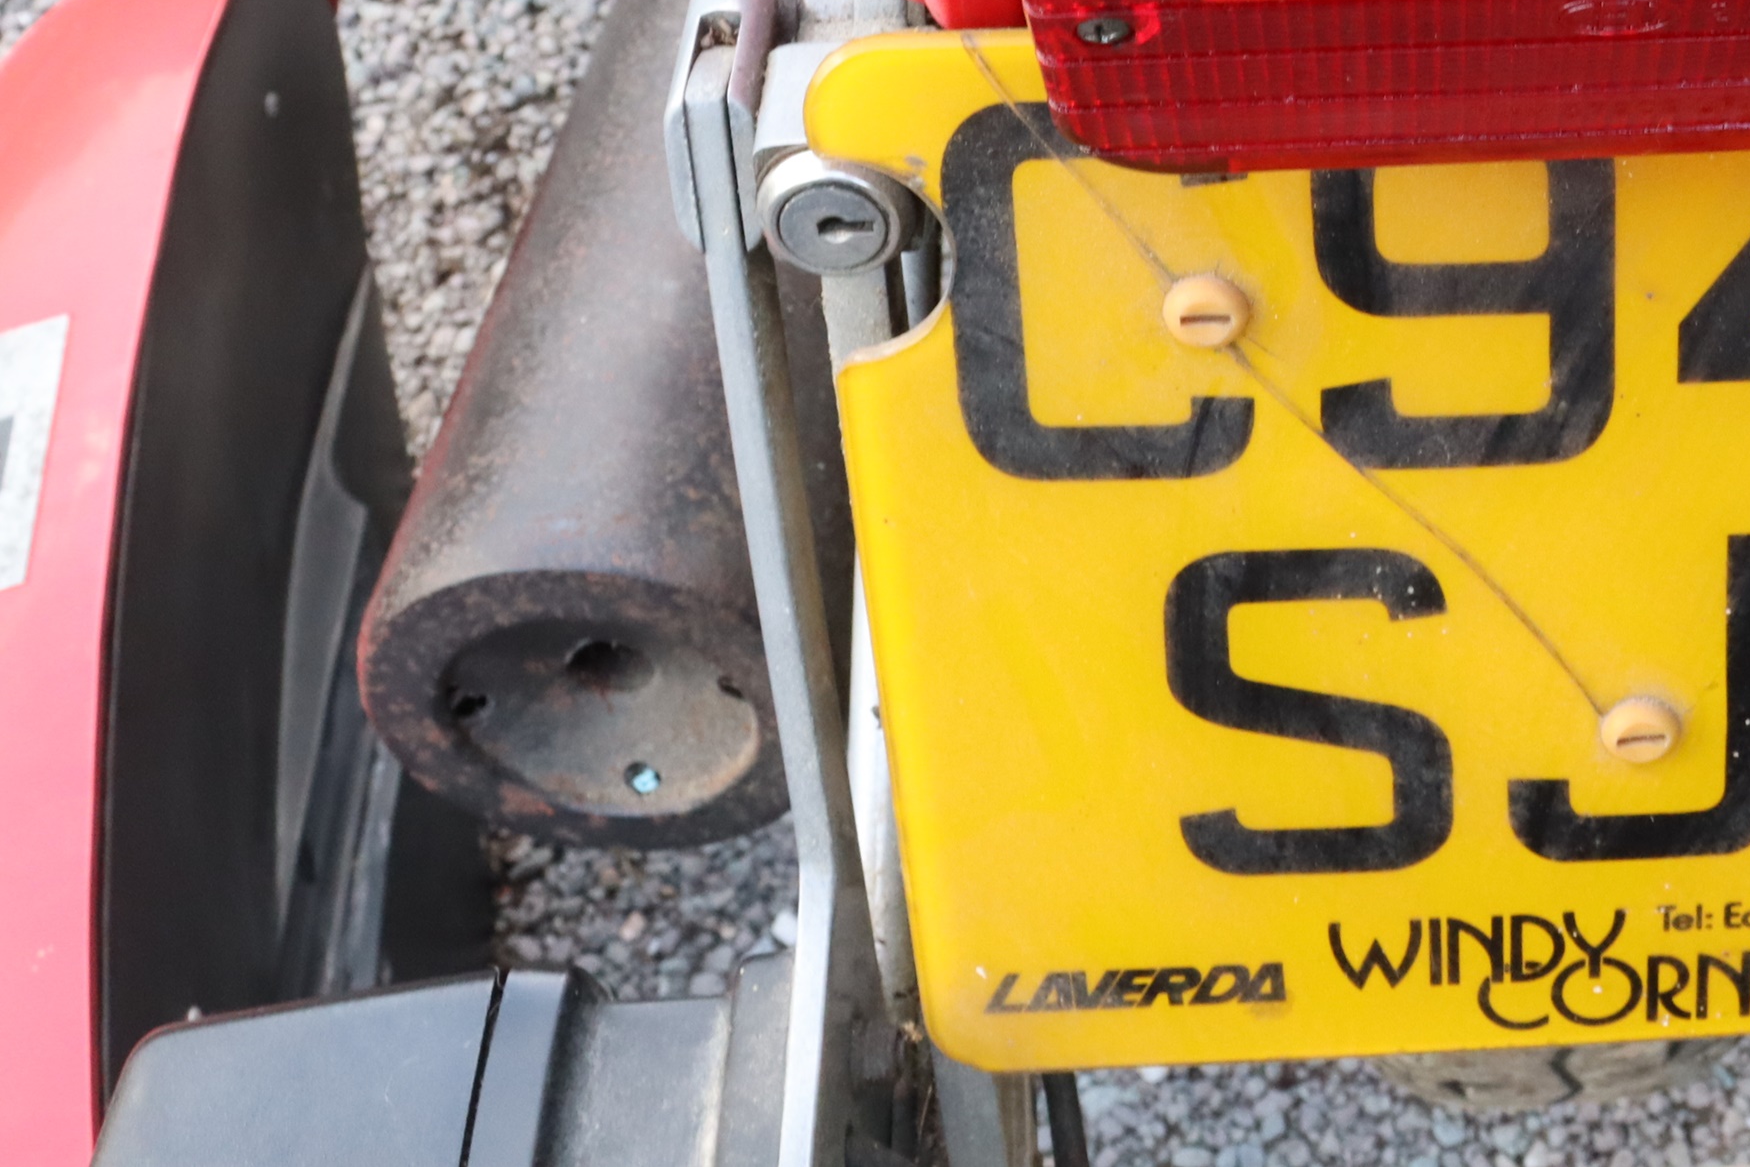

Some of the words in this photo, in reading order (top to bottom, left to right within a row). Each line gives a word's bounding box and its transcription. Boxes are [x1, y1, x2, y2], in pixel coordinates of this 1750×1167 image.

[1658, 900, 1713, 932] Tel:
[1328, 908, 1627, 990] WINDY
[984, 962, 1287, 1015] LAVERDA
